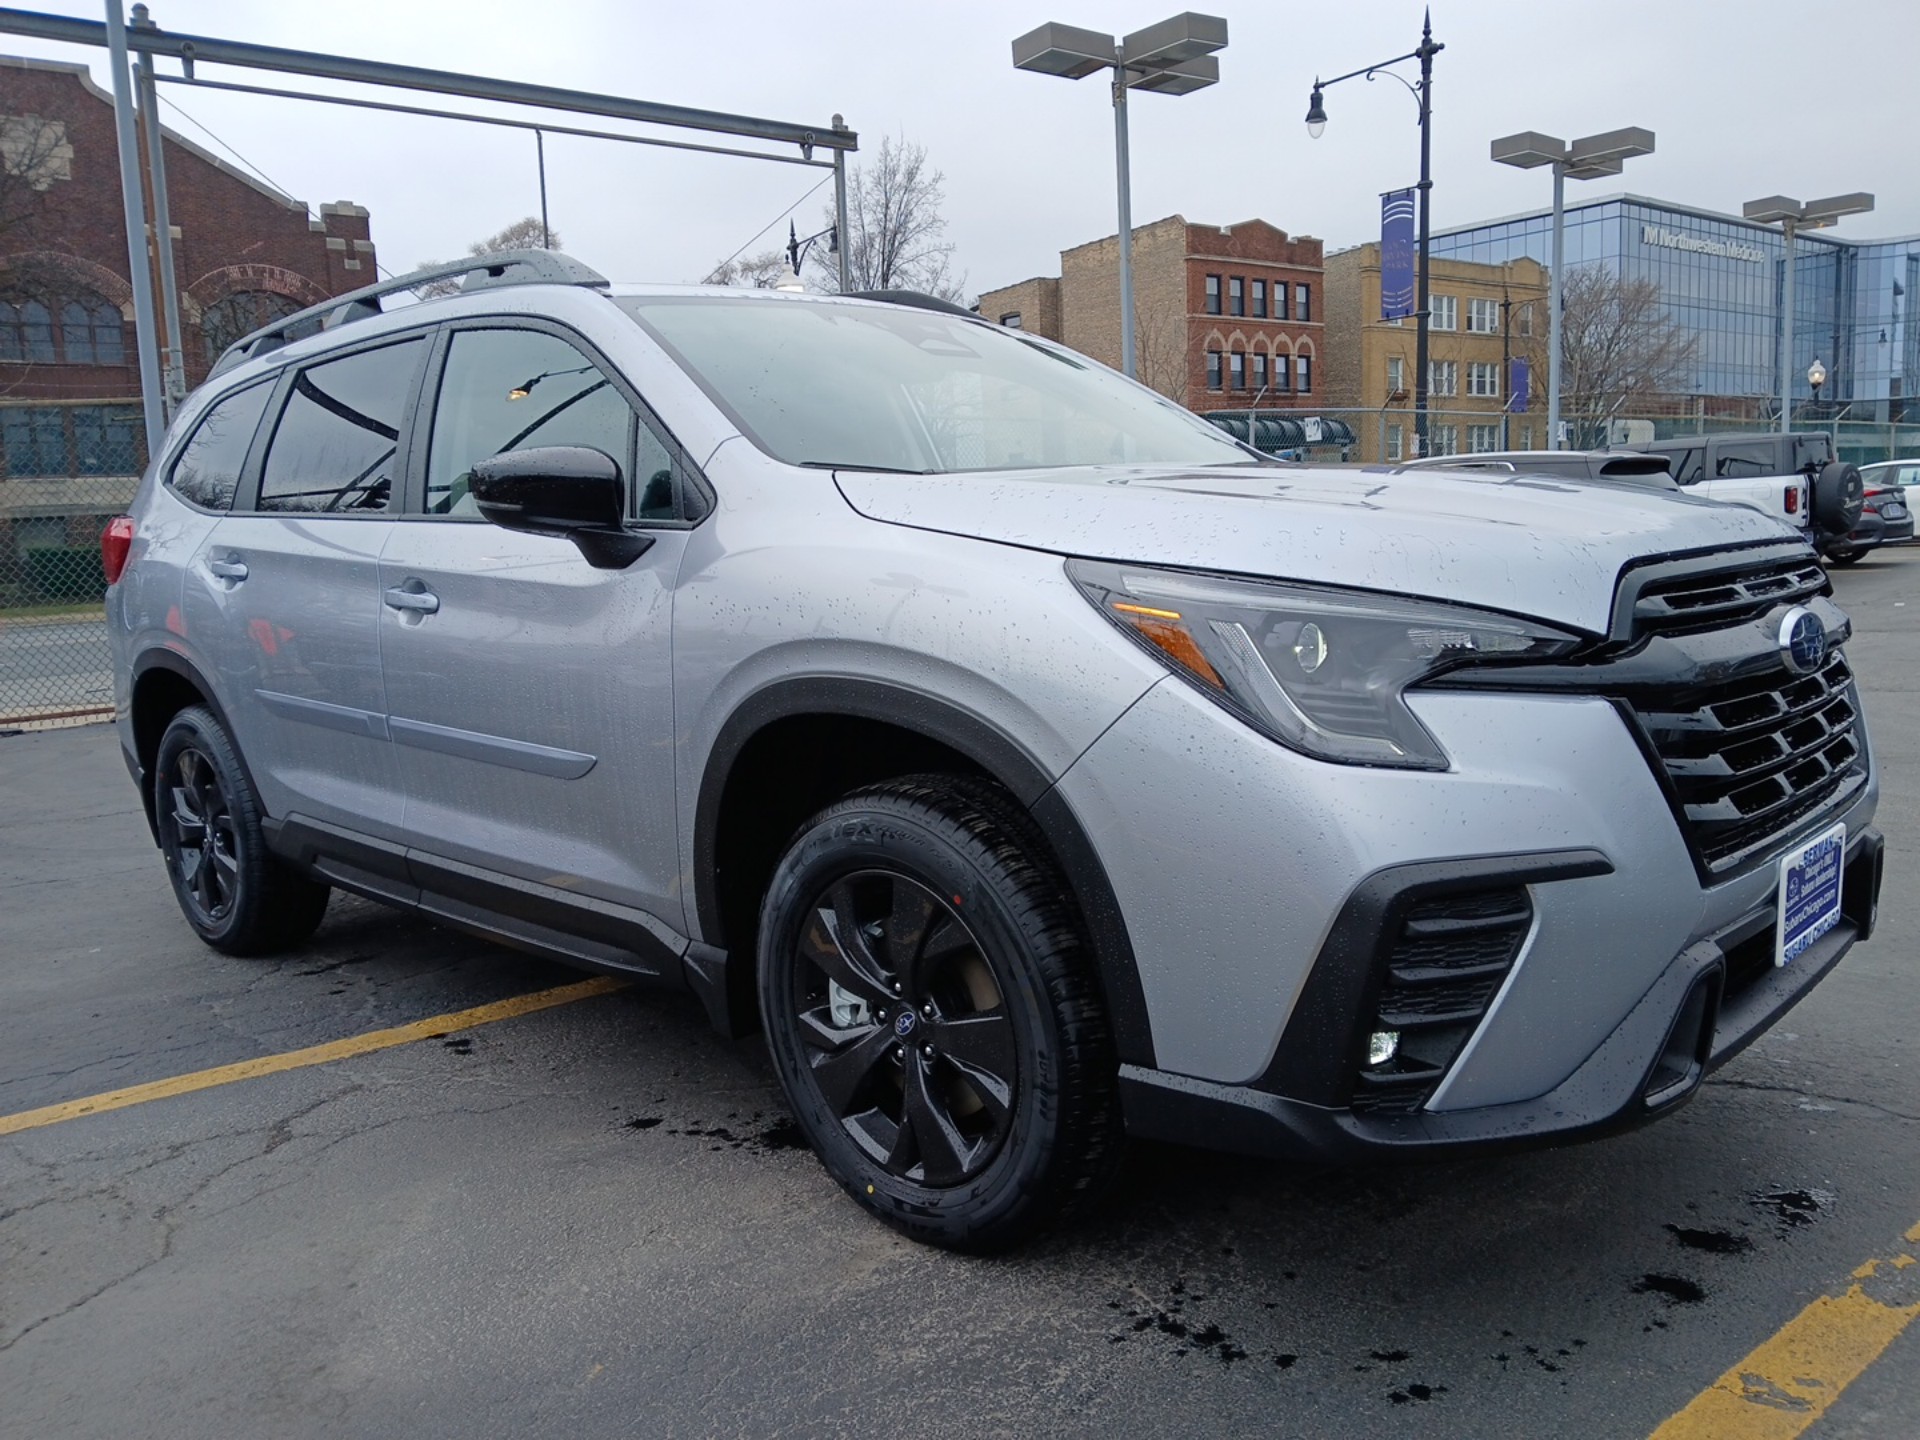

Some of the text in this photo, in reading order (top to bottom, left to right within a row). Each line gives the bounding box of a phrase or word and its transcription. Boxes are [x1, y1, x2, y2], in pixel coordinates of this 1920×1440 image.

[1659, 228, 1726, 257] Northwestern
[1726, 241, 1765, 263] Medicine
[1804, 834, 1834, 865] BERMAN
[1785, 889, 1835, 934] SubaruChicago.com
[1784, 930, 1813, 964] SUBARU
